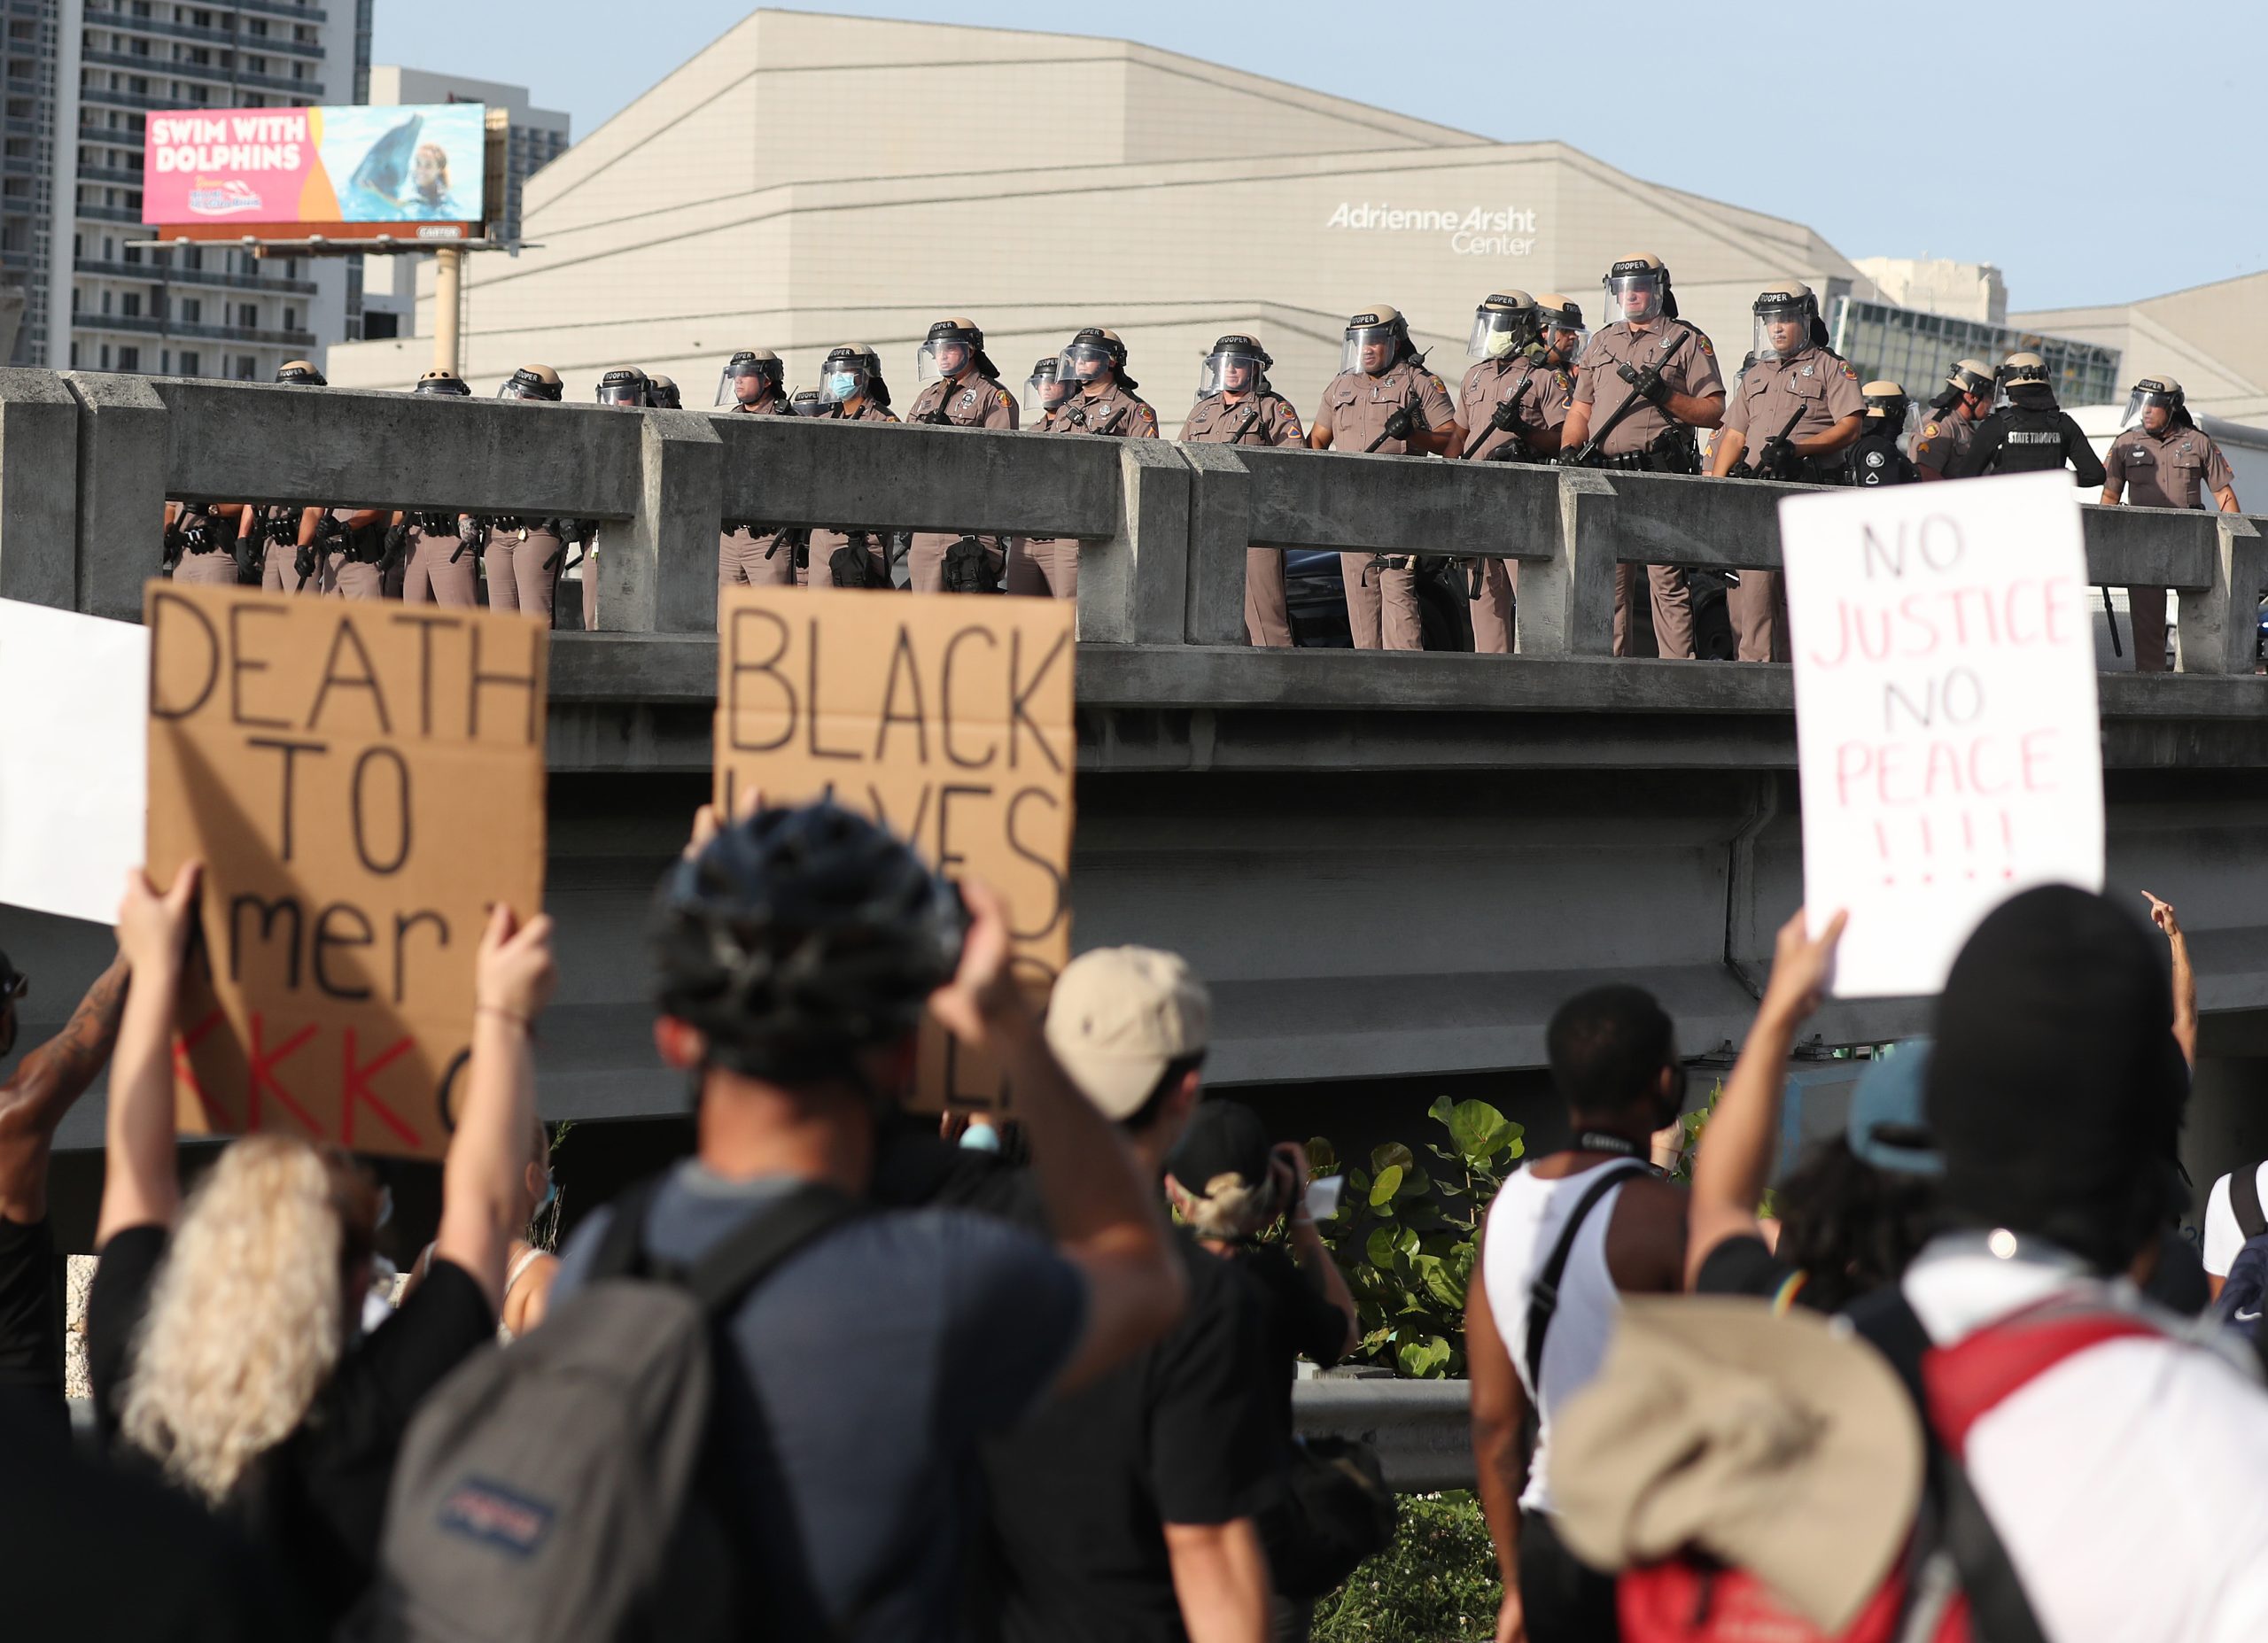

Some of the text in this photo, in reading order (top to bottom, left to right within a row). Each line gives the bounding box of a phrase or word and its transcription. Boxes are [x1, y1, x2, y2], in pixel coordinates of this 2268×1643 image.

[152, 116, 306, 145] SWIM WITH
[156, 143, 301, 173] DOLPHINS
[1327, 202, 1536, 233] Adrienne Arsht
[1451, 231, 1536, 255] Center
[2008, 431, 2062, 444] STATE TROOPER
[1863, 513, 1963, 579] NO
[1809, 577, 2073, 670] JUSTICE
[149, 592, 540, 744] DEATH
[730, 607, 1068, 772] BLACK
[1884, 666, 1984, 732] NO
[1836, 727, 2060, 810] PEACE
[246, 736, 413, 875] TO
